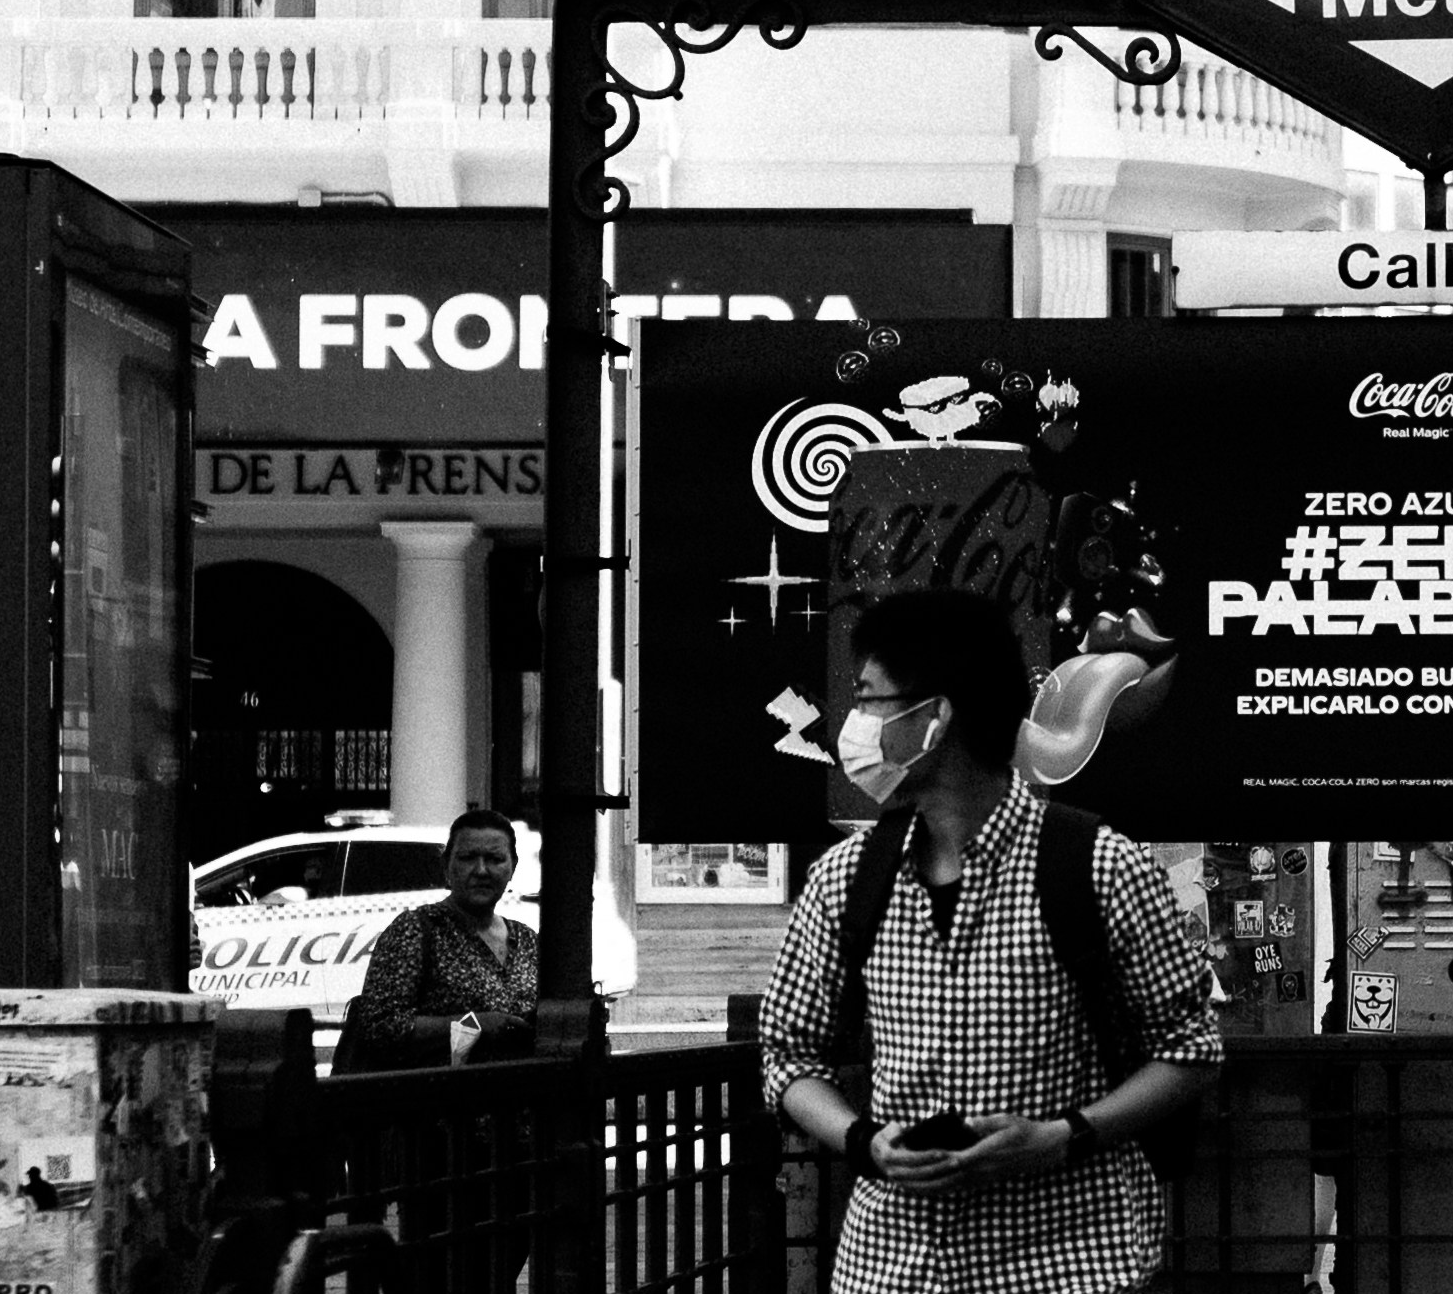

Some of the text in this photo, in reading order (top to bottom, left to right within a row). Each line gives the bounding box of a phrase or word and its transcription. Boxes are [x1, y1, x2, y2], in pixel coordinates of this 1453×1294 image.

[1383, 427, 1451, 440] Real Magic
[209, 453, 362, 495] DE LA
[1304, 492, 1392, 515] ZERO
[1255, 667, 1414, 688] DEMASIADO
[1236, 695, 1399, 715] EXPLICARLO
[1243, 778, 1267, 786] REAL
[1355, 778, 1380, 786] ZERO
[1255, 944, 1276, 959] OYE
[1255, 955, 1283, 974] RUNS
